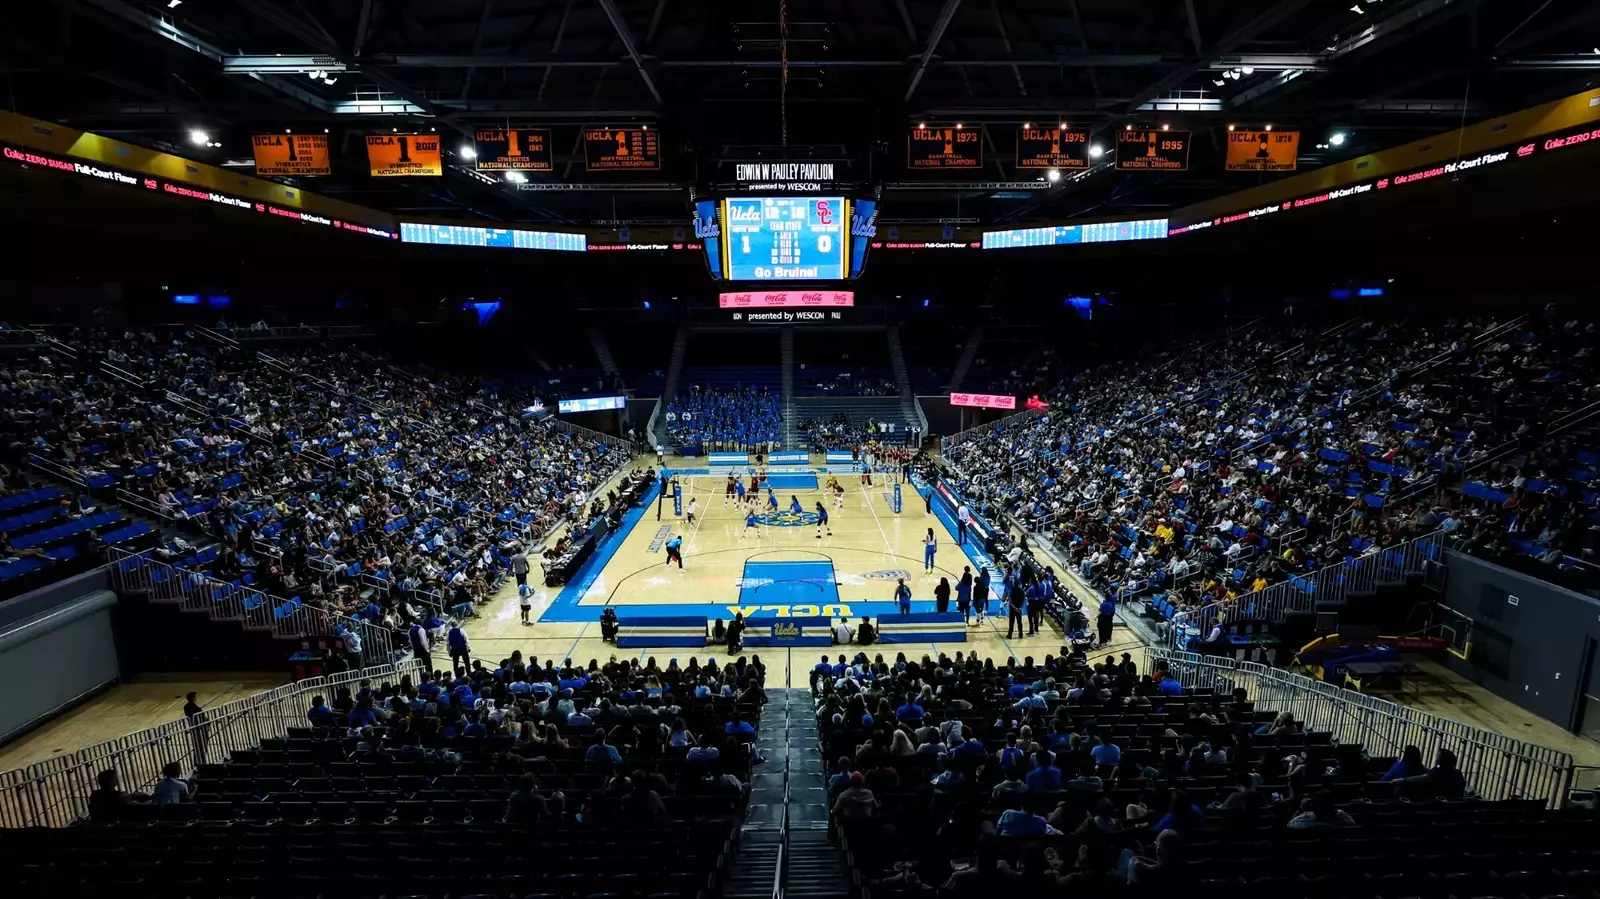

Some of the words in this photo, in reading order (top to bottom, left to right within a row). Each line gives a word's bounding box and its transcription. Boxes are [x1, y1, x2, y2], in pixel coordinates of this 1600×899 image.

[254, 136, 283, 146] UCLA
[287, 137, 297, 161] 1
[368, 137, 394, 145] UCLA
[397, 137, 411, 162] 1
[416, 142, 437, 151] 2018
[476, 131, 505, 141] UCLA
[506, 131, 521, 156] 1
[586, 132, 612, 141] UCLA
[616, 132, 629, 156] 1
[913, 130, 942, 140] UCLA
[944, 130, 953, 154] 1
[957, 133, 977, 142] 1973
[1023, 130, 1051, 140] UCLA
[1051, 130, 1060, 154] 1
[1065, 133, 1085, 142] 1975
[1119, 132, 1146, 142] UCLA
[1147, 132, 1157, 156] 1
[1161, 140, 1183, 150] 1995
[1230, 133, 1257, 142] UCLA
[1256, 133, 1269, 158] 1
[1544, 138, 1566, 150] Coke
[1565, 133, 1590, 145] ZERO
[4, 148, 25, 161] Coke
[25, 154, 48, 166] ZERO
[48, 159, 75, 172] SUGAR
[75, 163, 114, 180] Full-Court
[114, 172, 137, 185] Flavor
[736, 164, 761, 181] EDWIN
[761, 163, 770, 180] W
[771, 163, 799, 180] PAULEY
[800, 163, 834, 180] PAVILION
[1394, 176, 1408, 185] Coke
[1407, 172, 1422, 181] ZERO
[1423, 167, 1444, 178] SUGAR
[1482, 152, 1509, 165] Flavor
[164, 183, 178, 193] Coke
[178, 188, 192, 196] ZERO
[192, 191, 209, 200] SUGAR
[749, 183, 778, 191] presented
[778, 183, 787, 191] by
[787, 183, 821, 191] WESCOM
[731, 206, 761, 220] Ucla
[693, 216, 720, 239] Ucla
[852, 215, 877, 238] Ucla
[742, 235, 751, 253] 1
[818, 235, 832, 253] 0
[755, 267, 772, 278] Go
[774, 267, 818, 278] Bruins!
[748, 312, 782, 322] presented
[784, 311, 794, 322] by
[796, 312, 825, 320] WESCOM
[726, 604, 854, 618] UCLA
[774, 623, 800, 636] Ucla
